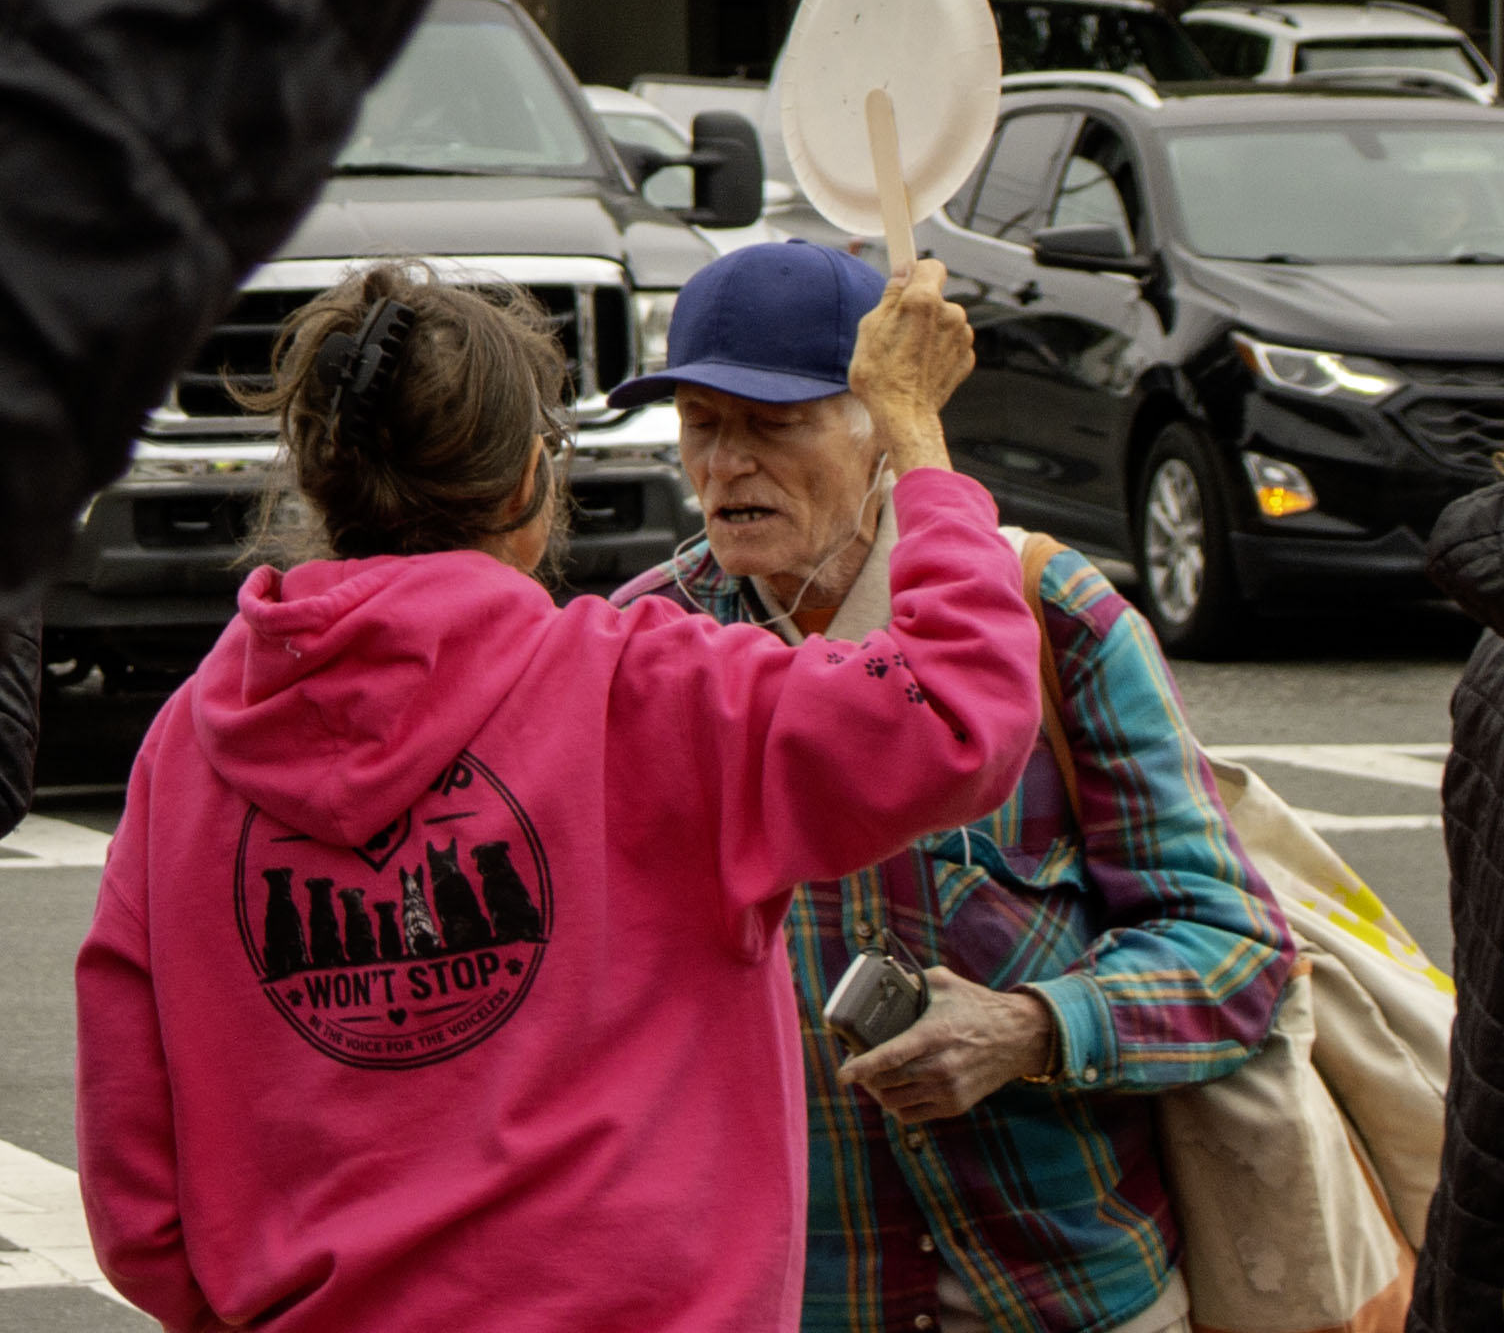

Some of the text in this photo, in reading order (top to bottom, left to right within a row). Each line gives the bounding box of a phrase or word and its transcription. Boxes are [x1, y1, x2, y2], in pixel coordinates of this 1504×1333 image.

[303, 951, 500, 1010] WON'T STOP
[346, 1037, 382, 1053] VOICE
[386, 1039, 414, 1053] FOR
[417, 1030, 446, 1048] THE
[447, 987, 510, 1037] VOICELESS
